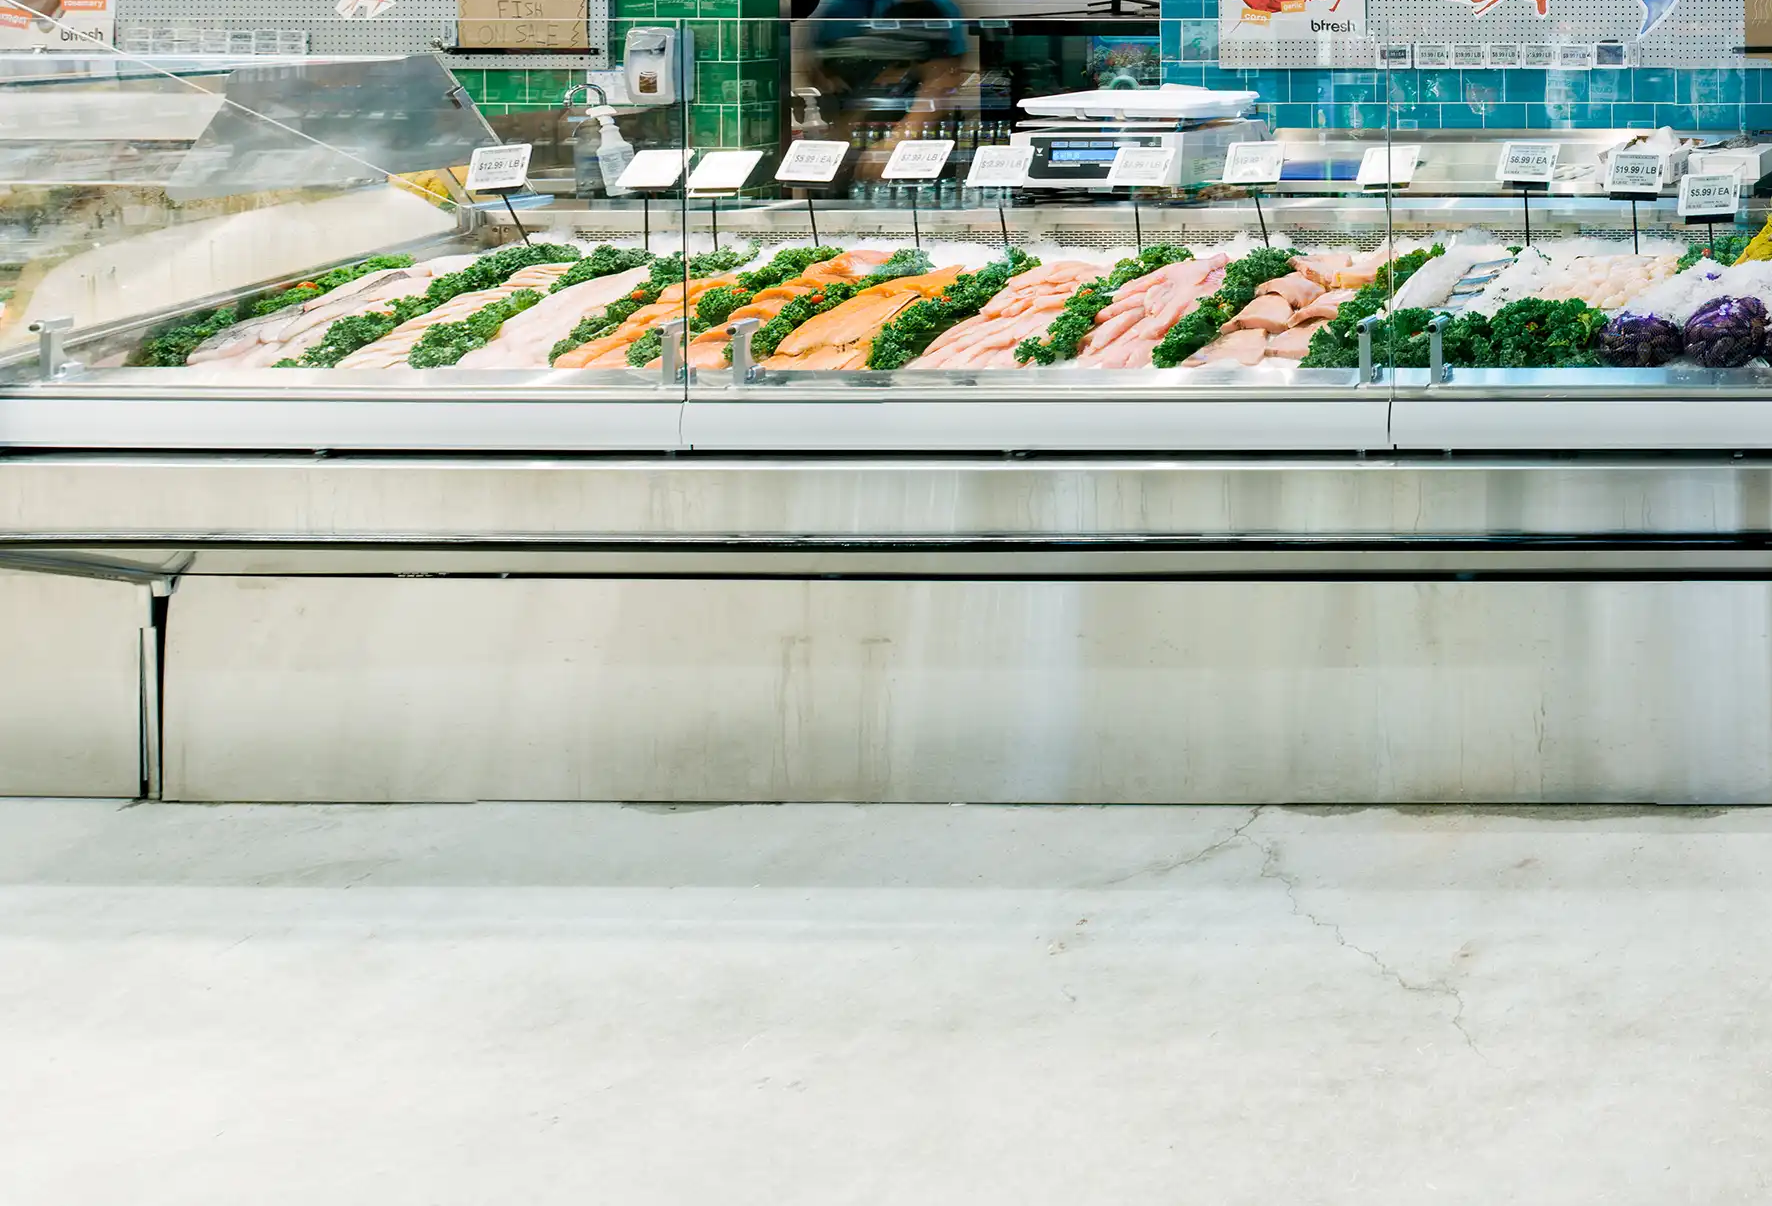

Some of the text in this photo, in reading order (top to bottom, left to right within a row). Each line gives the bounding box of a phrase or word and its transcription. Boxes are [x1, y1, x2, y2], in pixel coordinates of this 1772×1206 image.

[63, 0, 104, 9] rosemary
[497, 0, 544, 19] FISH
[1244, 13, 1268, 22] corn
[1311, 20, 1356, 33] bfresh
[478, 24, 559, 46] ON SALE
[1510, 155, 1530, 164] $6.99
[1536, 156, 1547, 164] EA
[479, 161, 503, 171] $12.99
[509, 159, 520, 168] LB
[1615, 165, 1640, 174] $19.99
[1646, 166, 1657, 174] LB
[1690, 188, 1712, 197] $5.99
[1718, 187, 1730, 195] EA
